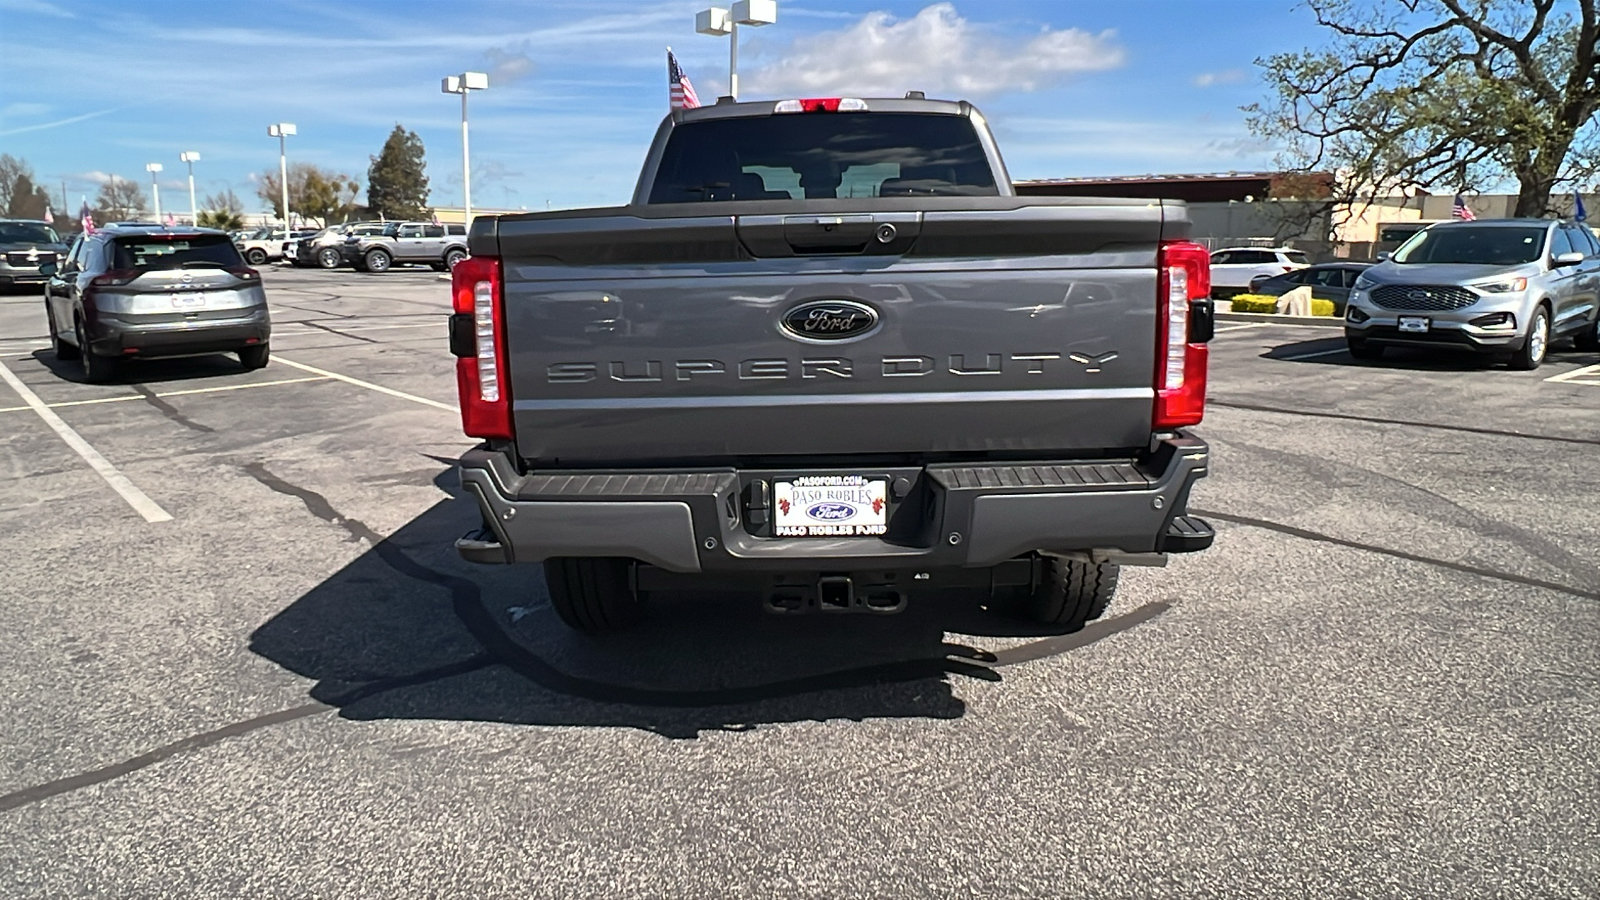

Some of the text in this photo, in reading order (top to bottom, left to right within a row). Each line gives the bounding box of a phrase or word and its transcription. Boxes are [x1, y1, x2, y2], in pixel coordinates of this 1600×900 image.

[804, 308, 855, 331] Ford
[547, 351, 1119, 383] SUPER DUTY
[798, 476, 863, 486] PASOFORD.COM
[792, 489, 872, 507] PASO ROBLES
[816, 504, 848, 518] Ford
[776, 526, 806, 536] PASO
[809, 525, 854, 536] ROBLES
